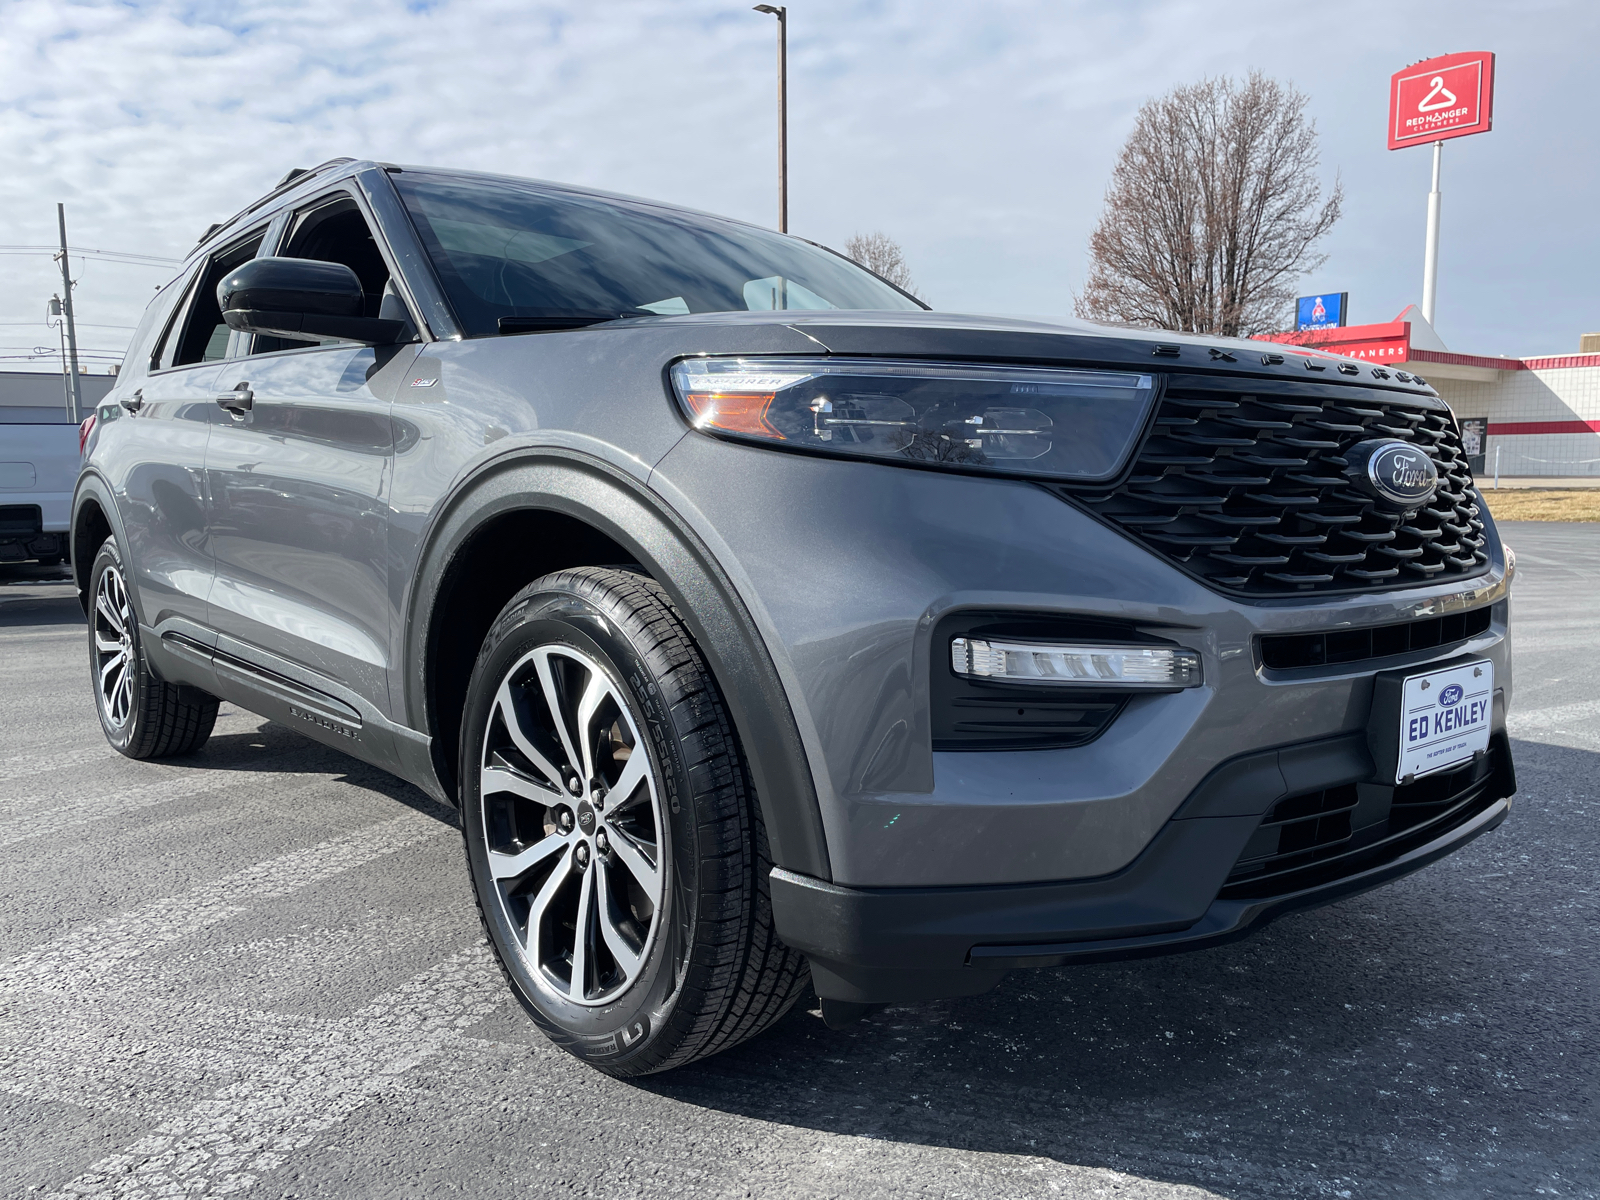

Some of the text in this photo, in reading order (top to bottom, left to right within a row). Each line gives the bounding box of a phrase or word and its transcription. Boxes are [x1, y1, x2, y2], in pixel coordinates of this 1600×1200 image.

[1406, 107, 1468, 127] RED HANGER
[1413, 118, 1460, 131] CLEANERS
[1393, 454, 1427, 488] Ford
[1443, 688, 1460, 704] Ford
[1409, 699, 1487, 741] ED KENLEY
[629, 672, 681, 814] 255/55R20
